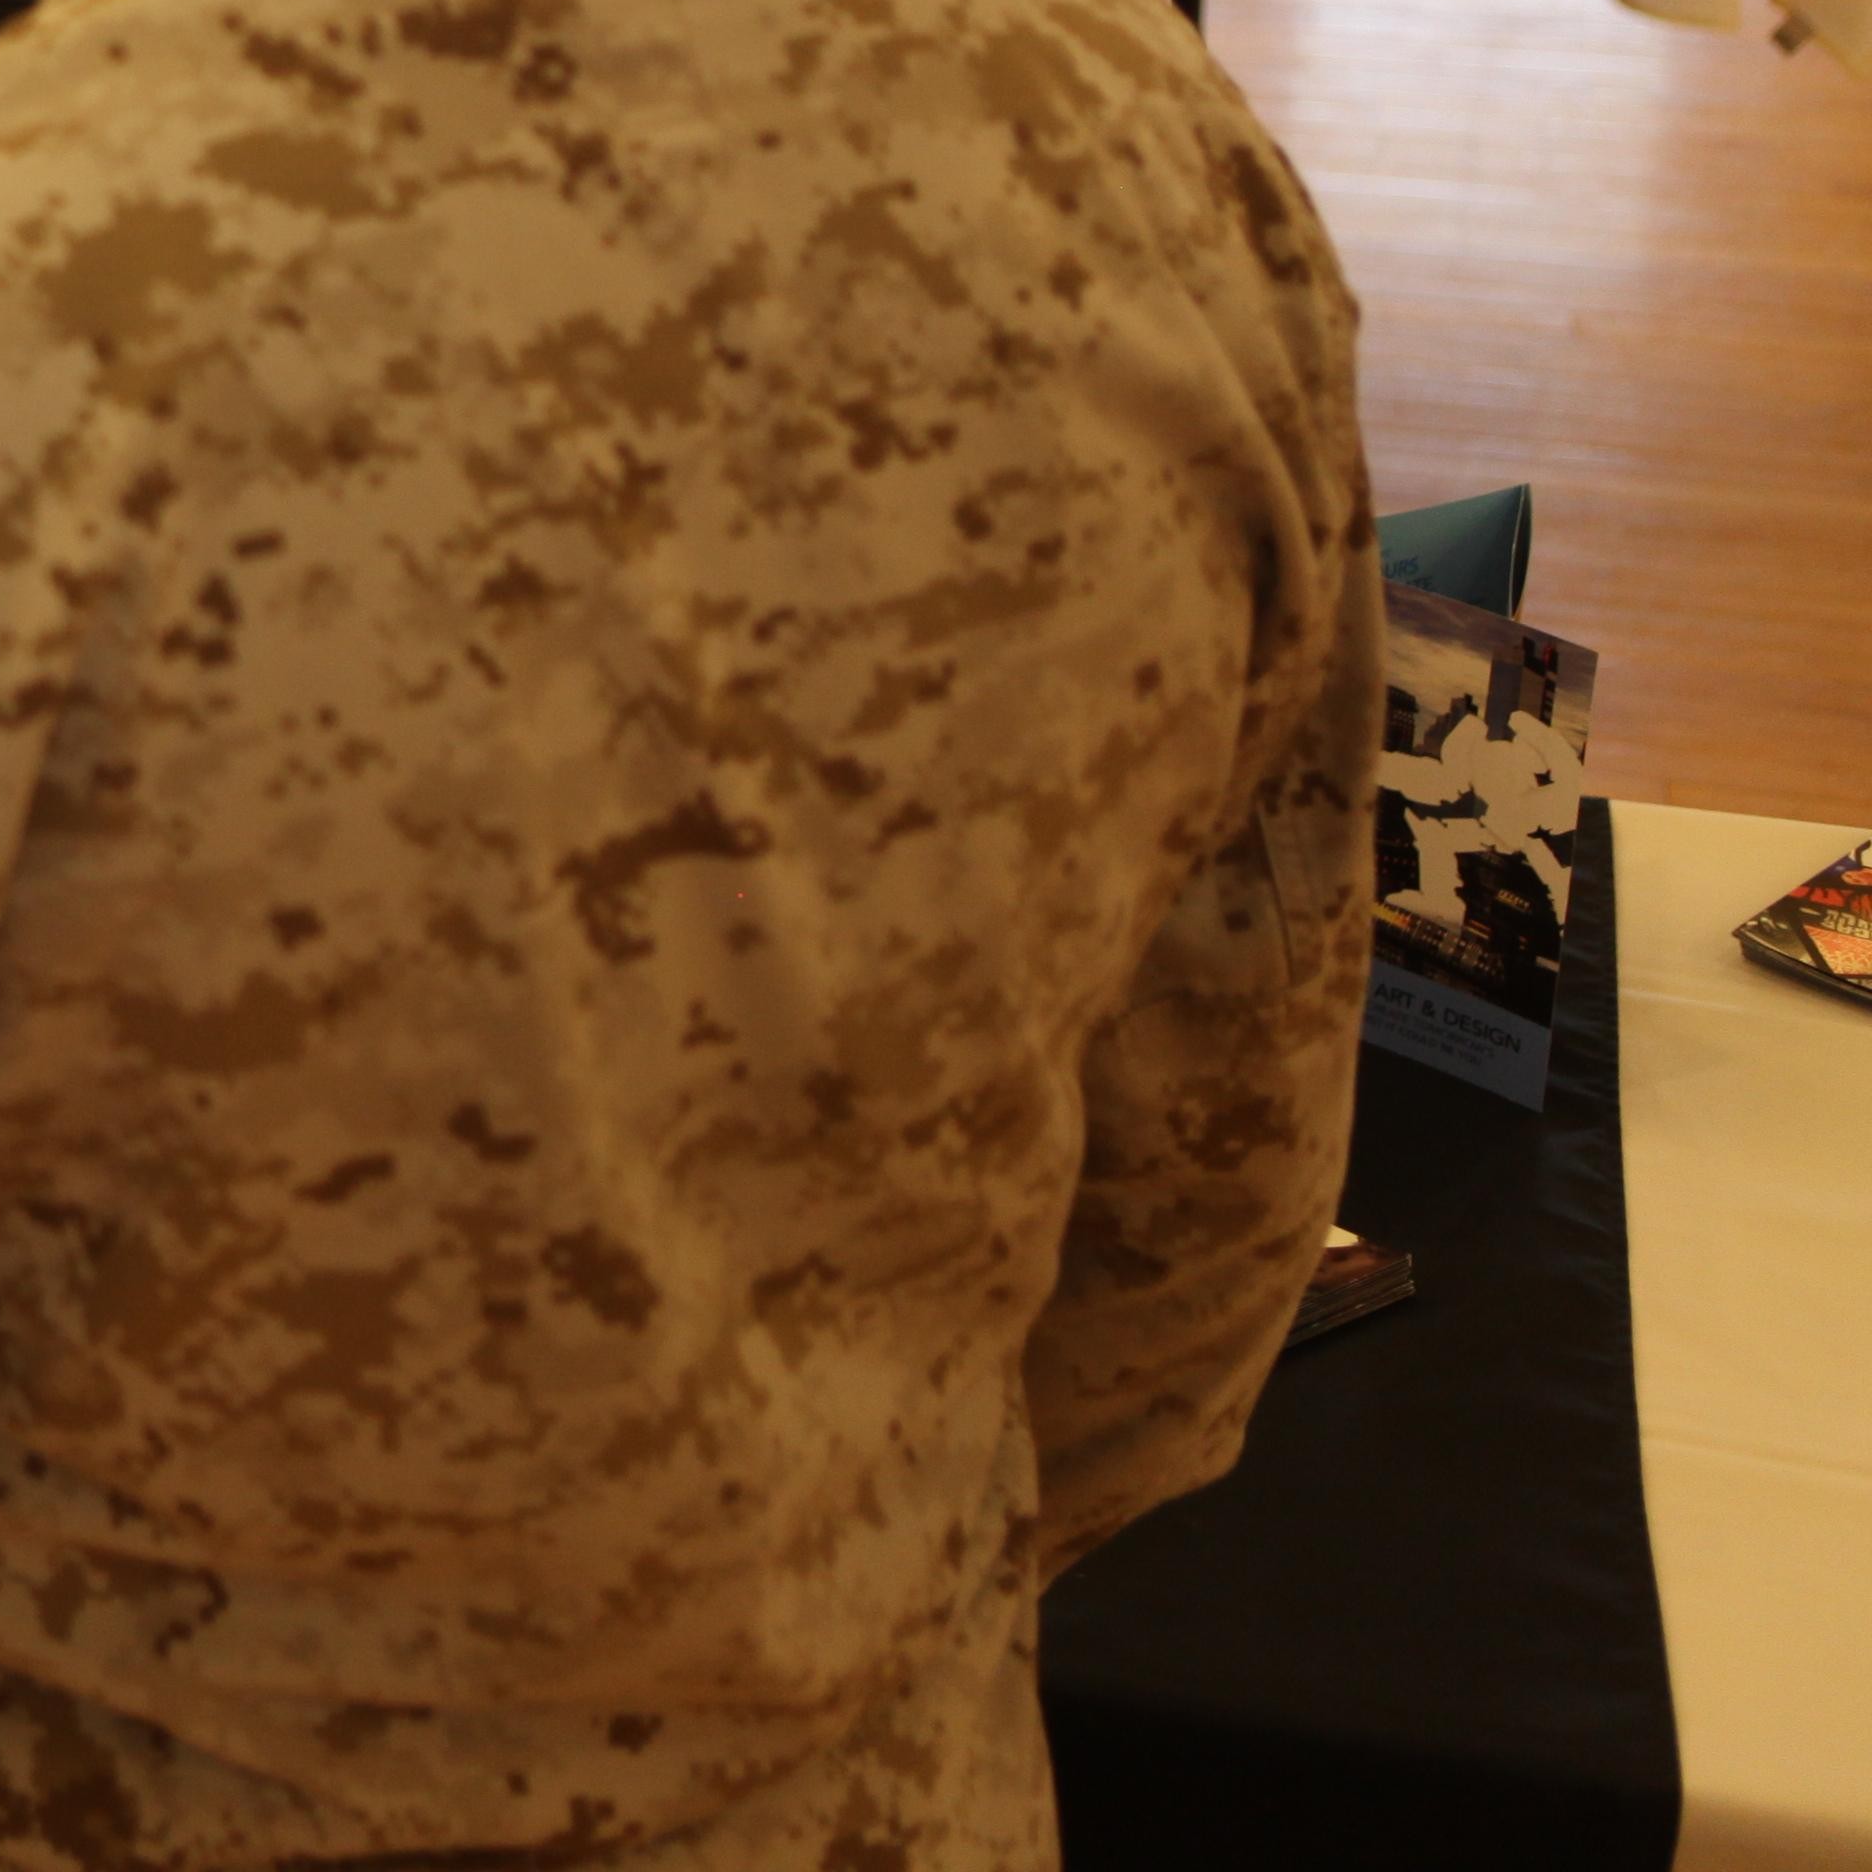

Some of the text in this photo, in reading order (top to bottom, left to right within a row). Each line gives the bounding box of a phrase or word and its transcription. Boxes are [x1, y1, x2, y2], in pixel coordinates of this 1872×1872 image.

[1374, 983, 1416, 1009] ART
[1421, 999, 1437, 1018] &
[1443, 1007, 1522, 1054] DESIGN
